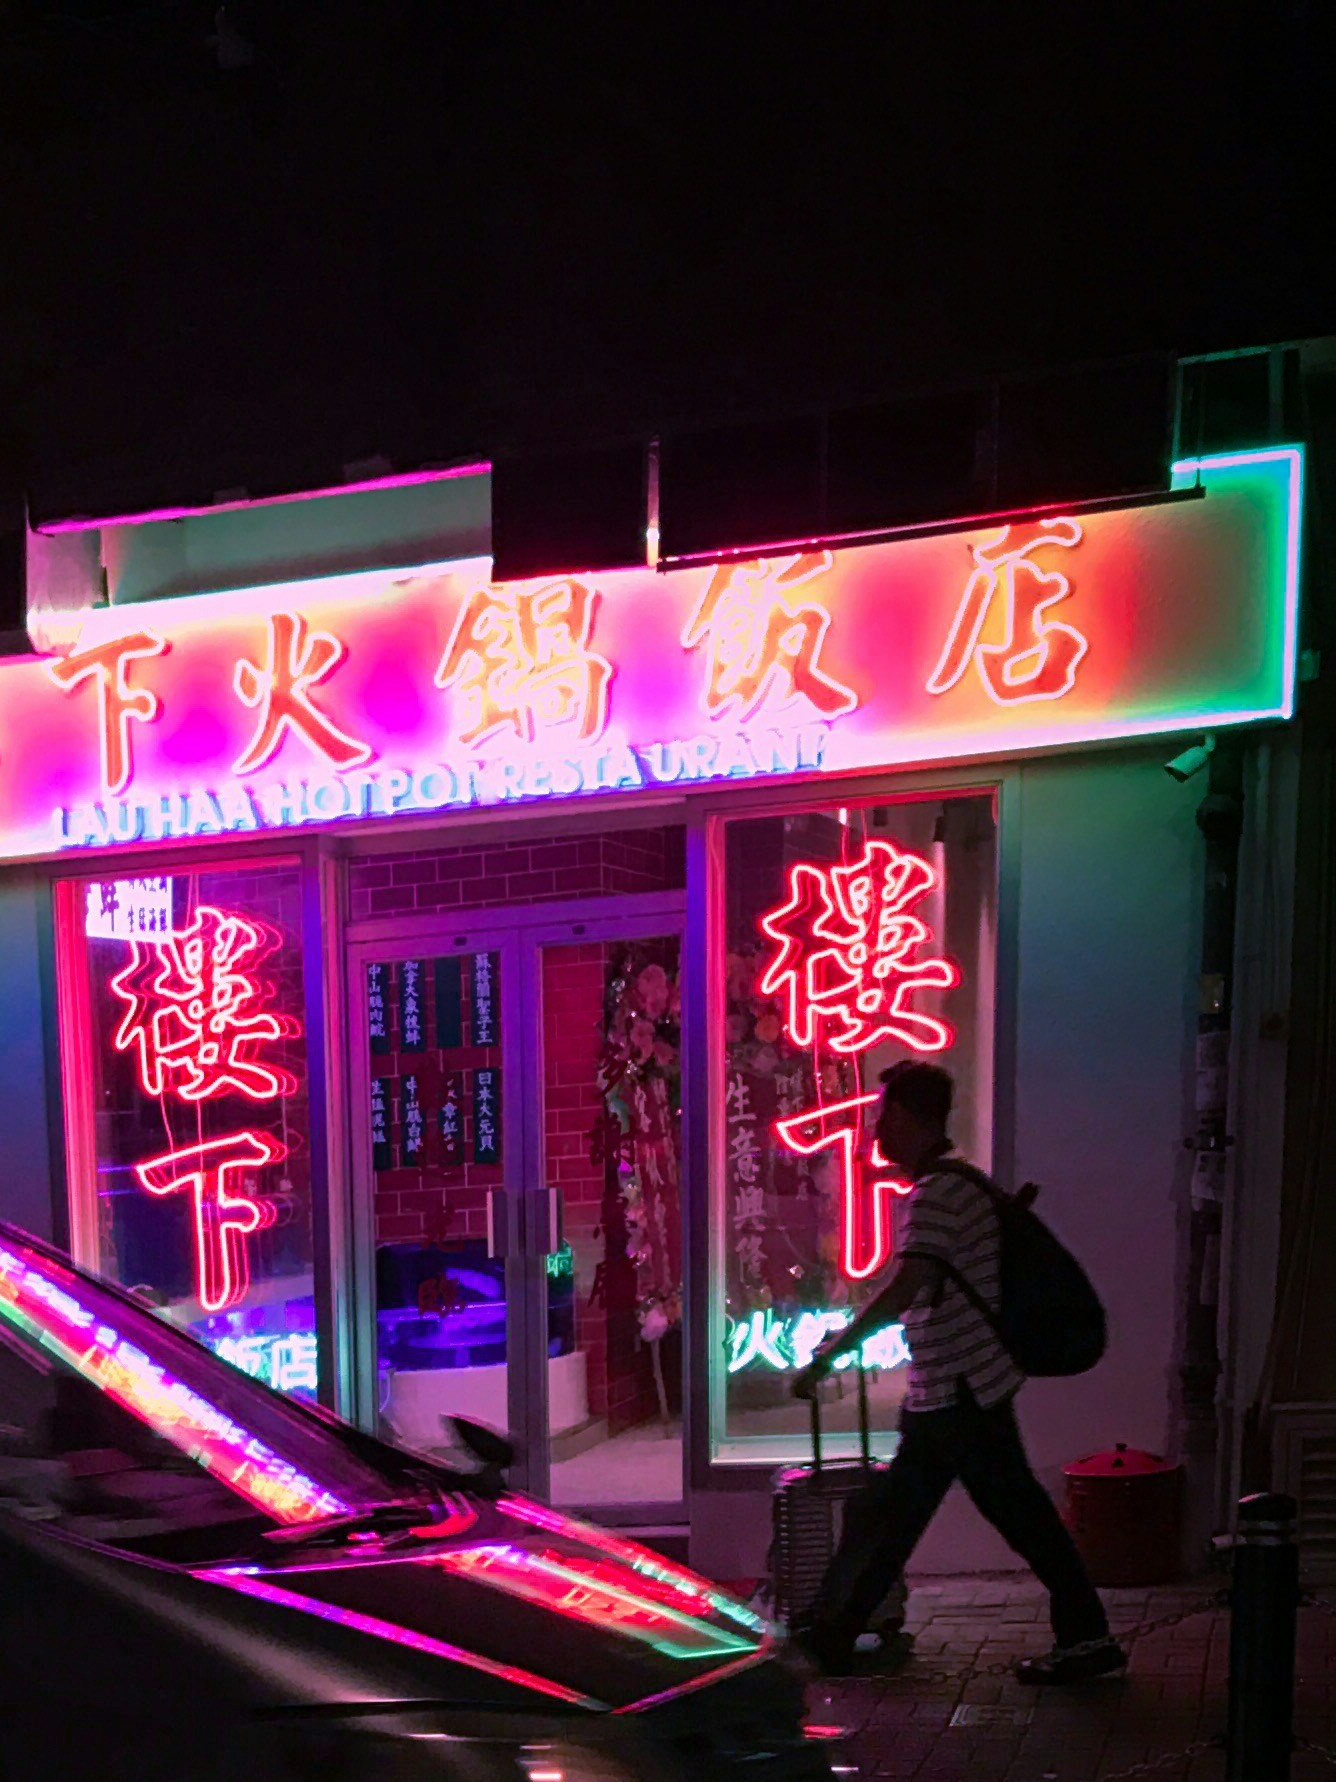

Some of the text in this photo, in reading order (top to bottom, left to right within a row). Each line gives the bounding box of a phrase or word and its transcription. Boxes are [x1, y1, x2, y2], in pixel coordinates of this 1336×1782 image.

[53, 796, 148, 849] LAU
[151, 781, 260, 839] HAA
[264, 770, 374, 825] HOT
[383, 756, 483, 815] POT
